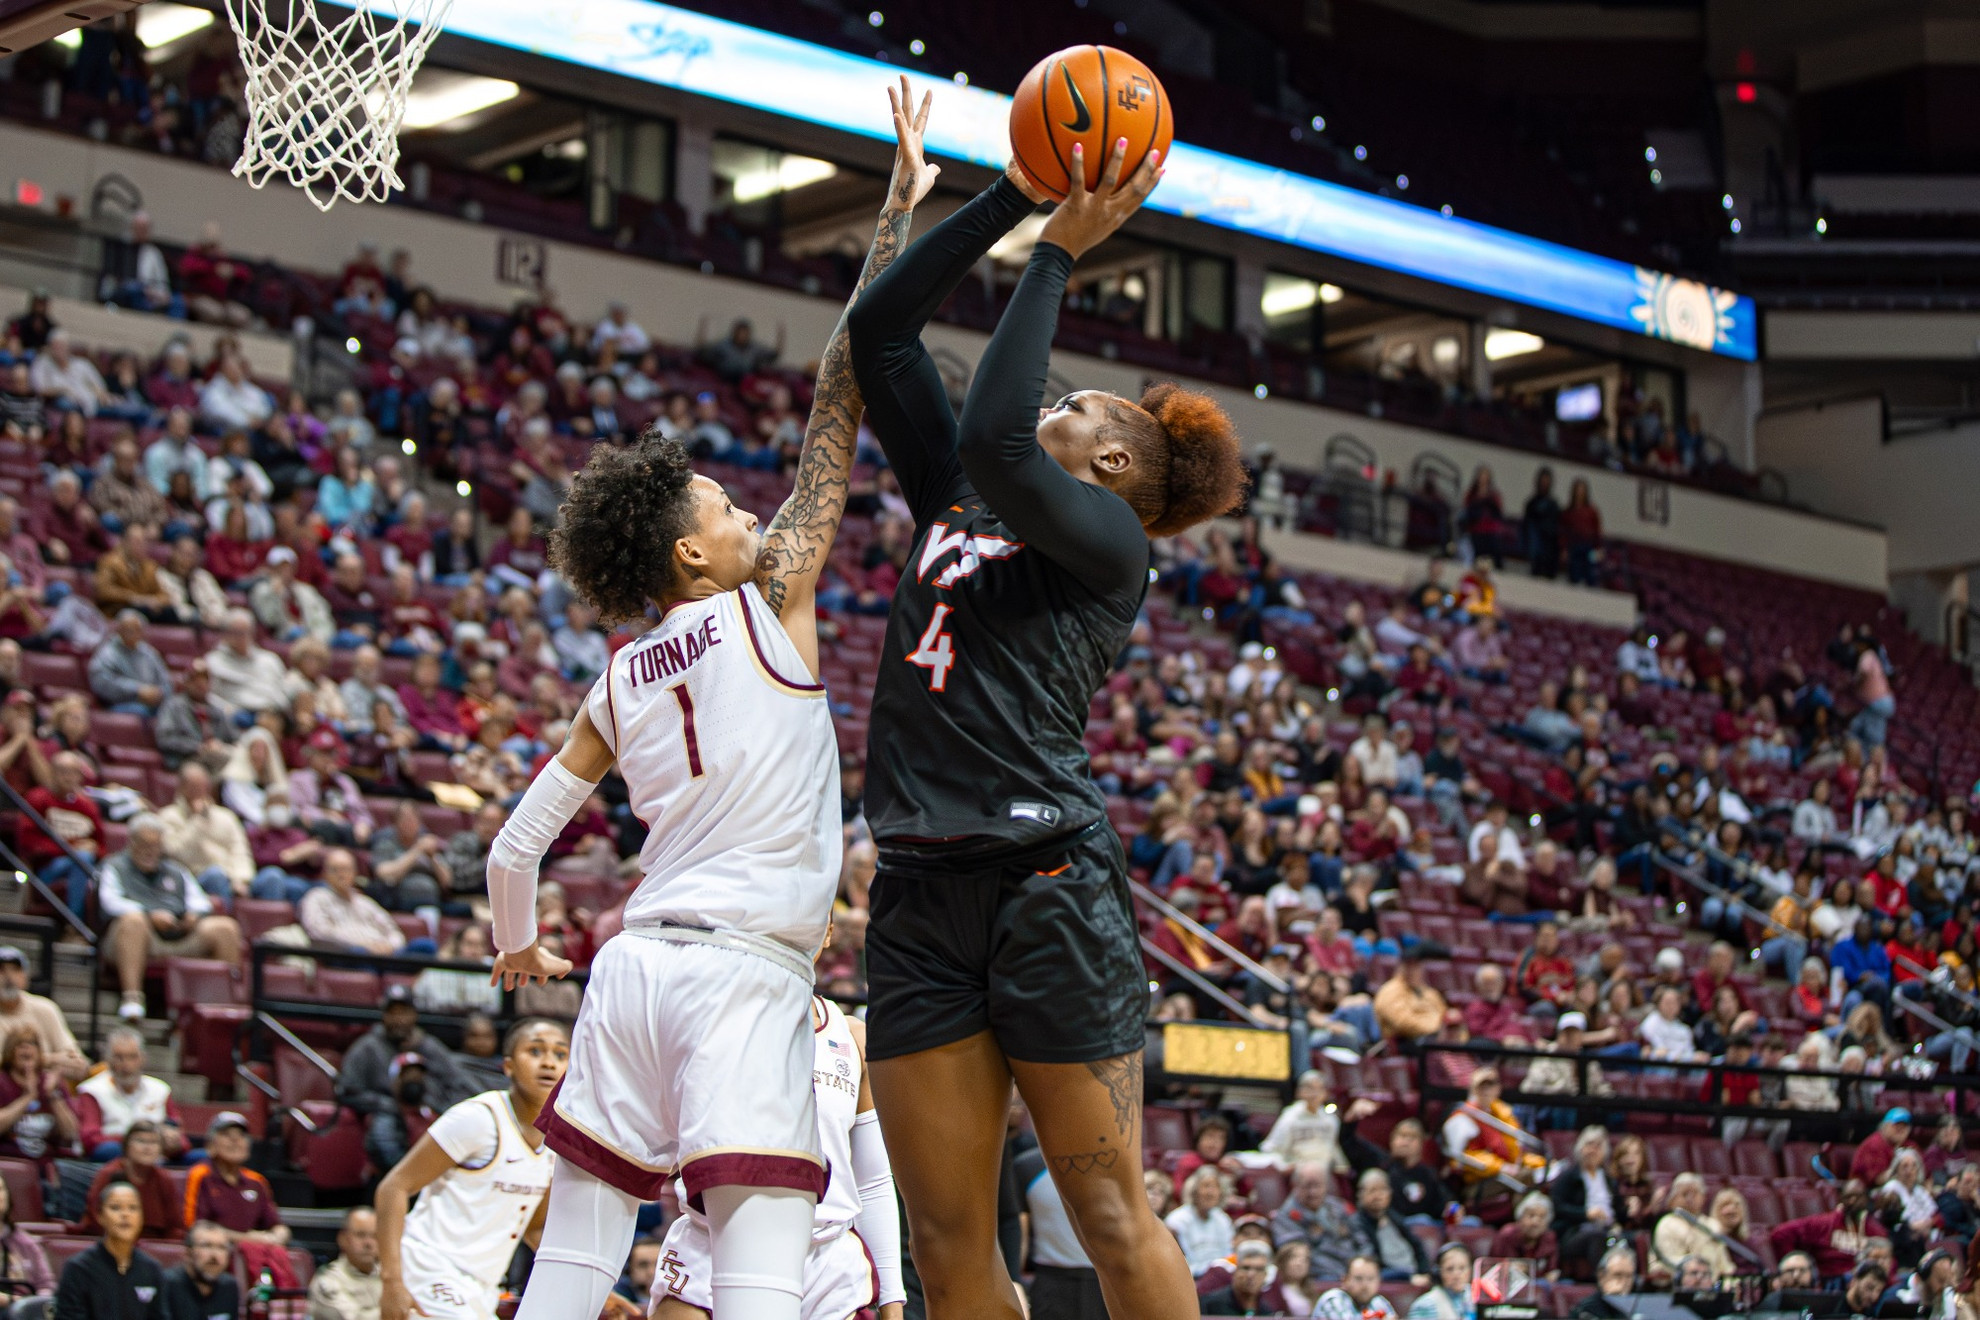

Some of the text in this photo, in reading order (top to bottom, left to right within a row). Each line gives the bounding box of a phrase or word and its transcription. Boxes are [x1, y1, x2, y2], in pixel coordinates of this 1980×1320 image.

[1117, 75, 1151, 110] FSU
[629, 614, 722, 687] TURNAGE
[904, 602, 956, 691] 4
[665, 680, 706, 779] 1
[813, 1069, 856, 1098] STATE
[660, 1249, 690, 1295] FSU
